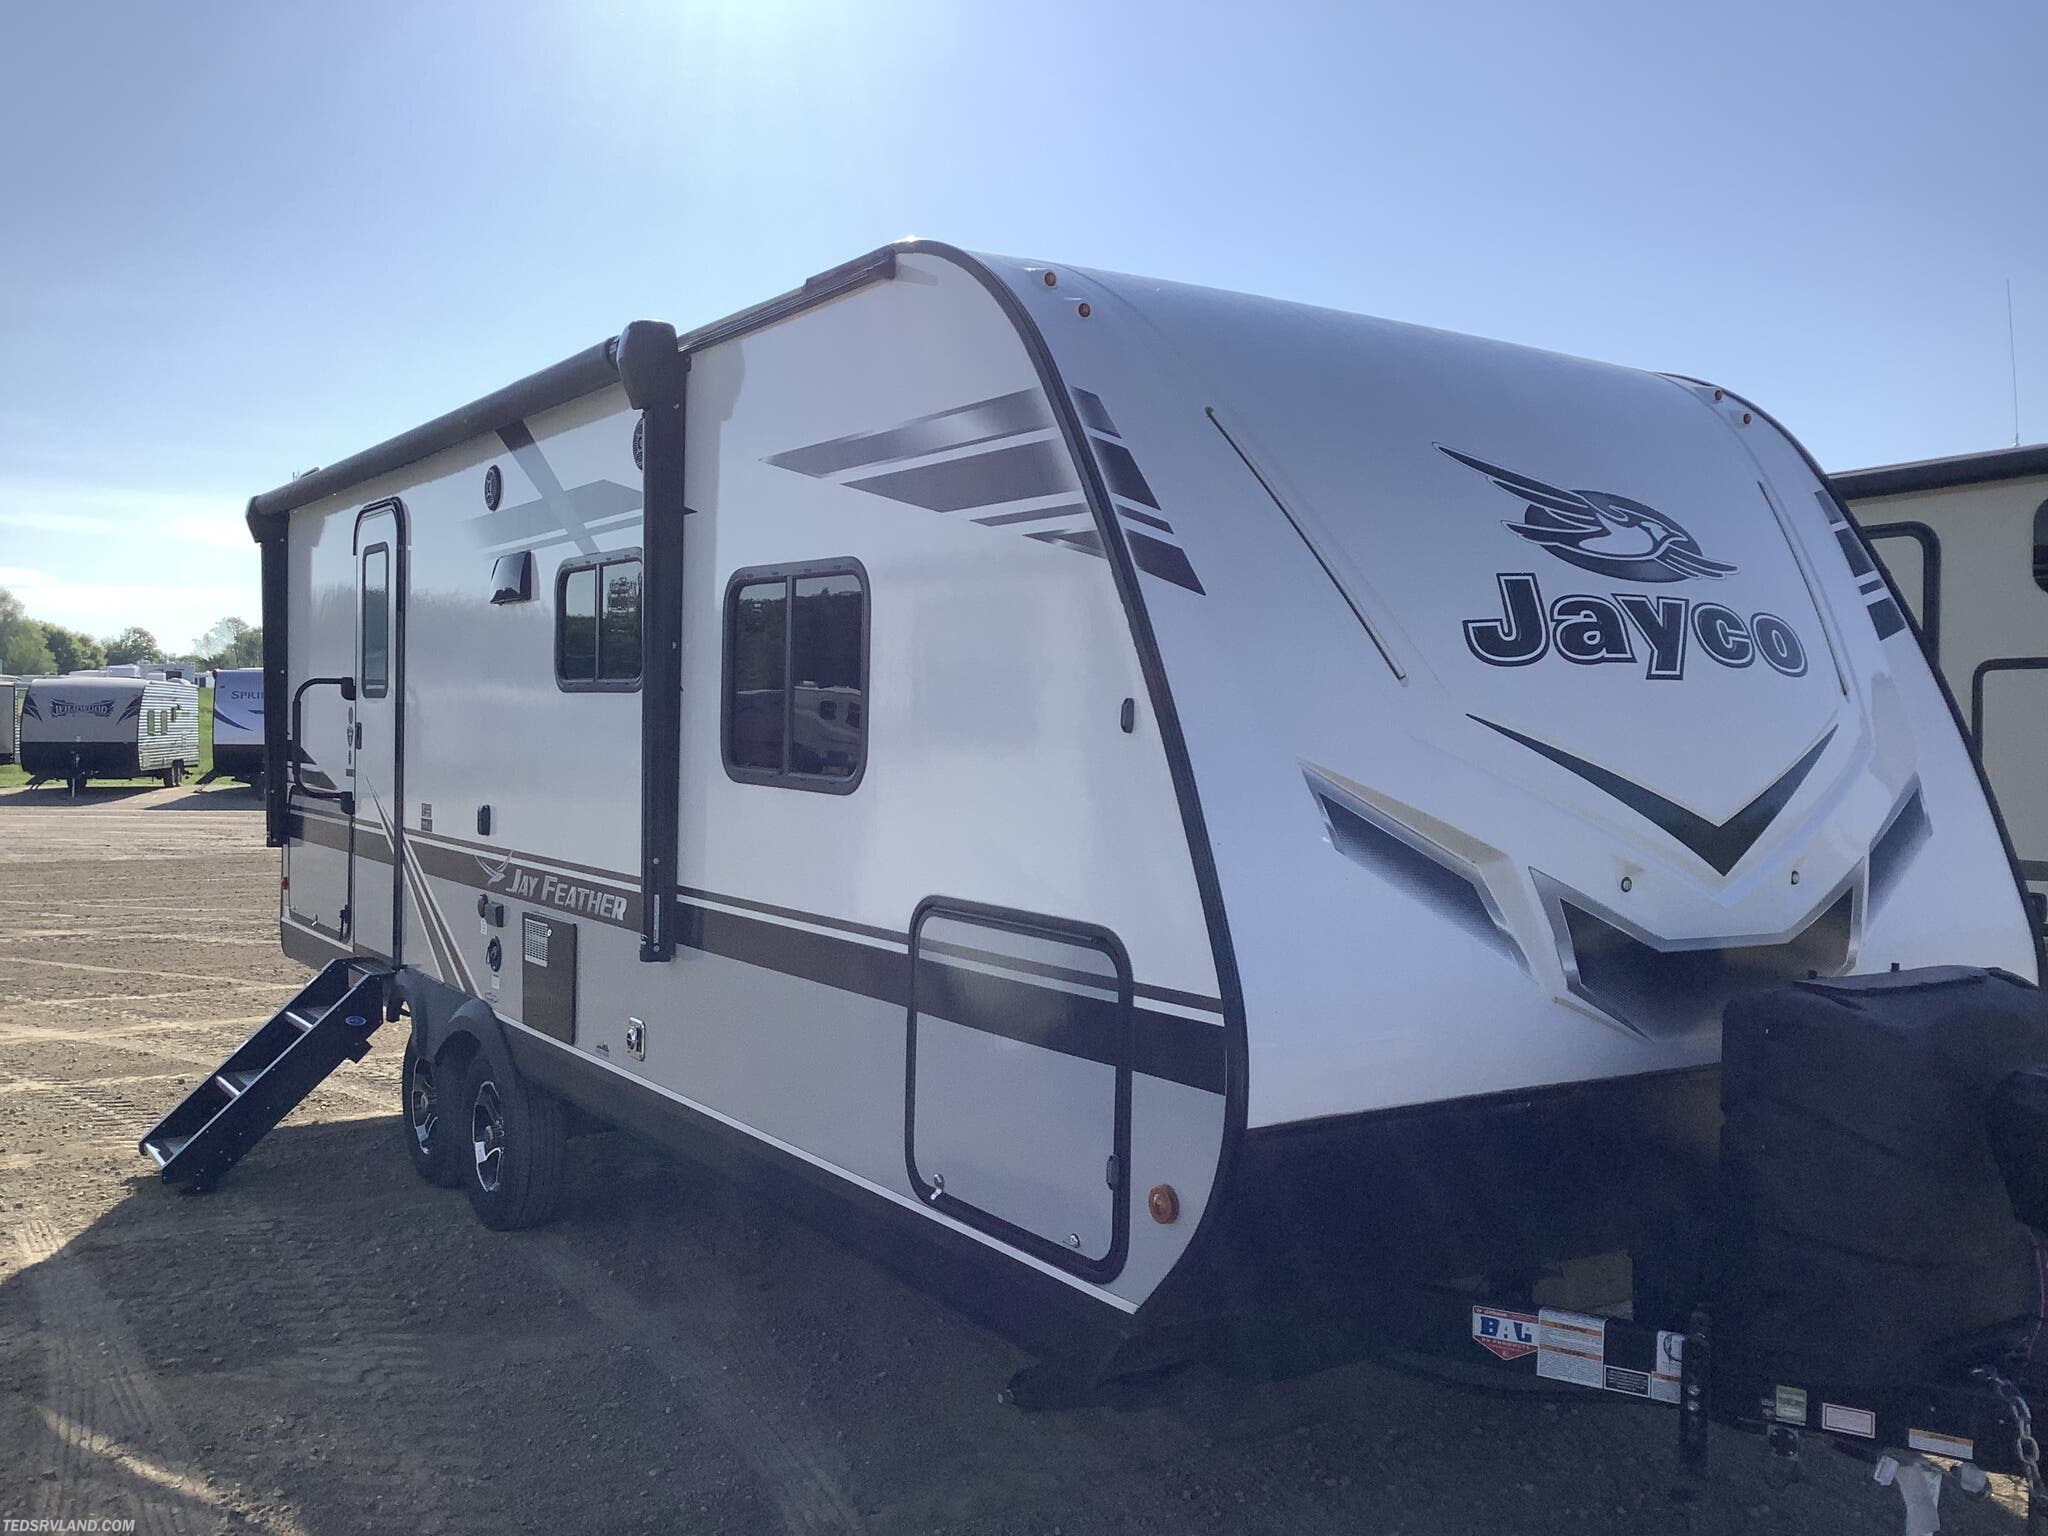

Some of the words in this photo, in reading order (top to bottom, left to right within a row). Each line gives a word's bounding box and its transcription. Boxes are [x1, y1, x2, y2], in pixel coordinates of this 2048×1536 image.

[1462, 572, 1808, 680] Jayco
[506, 868, 539, 897] JAY
[541, 875, 627, 921] FEATHER
[1480, 1316, 1532, 1343] BAL
